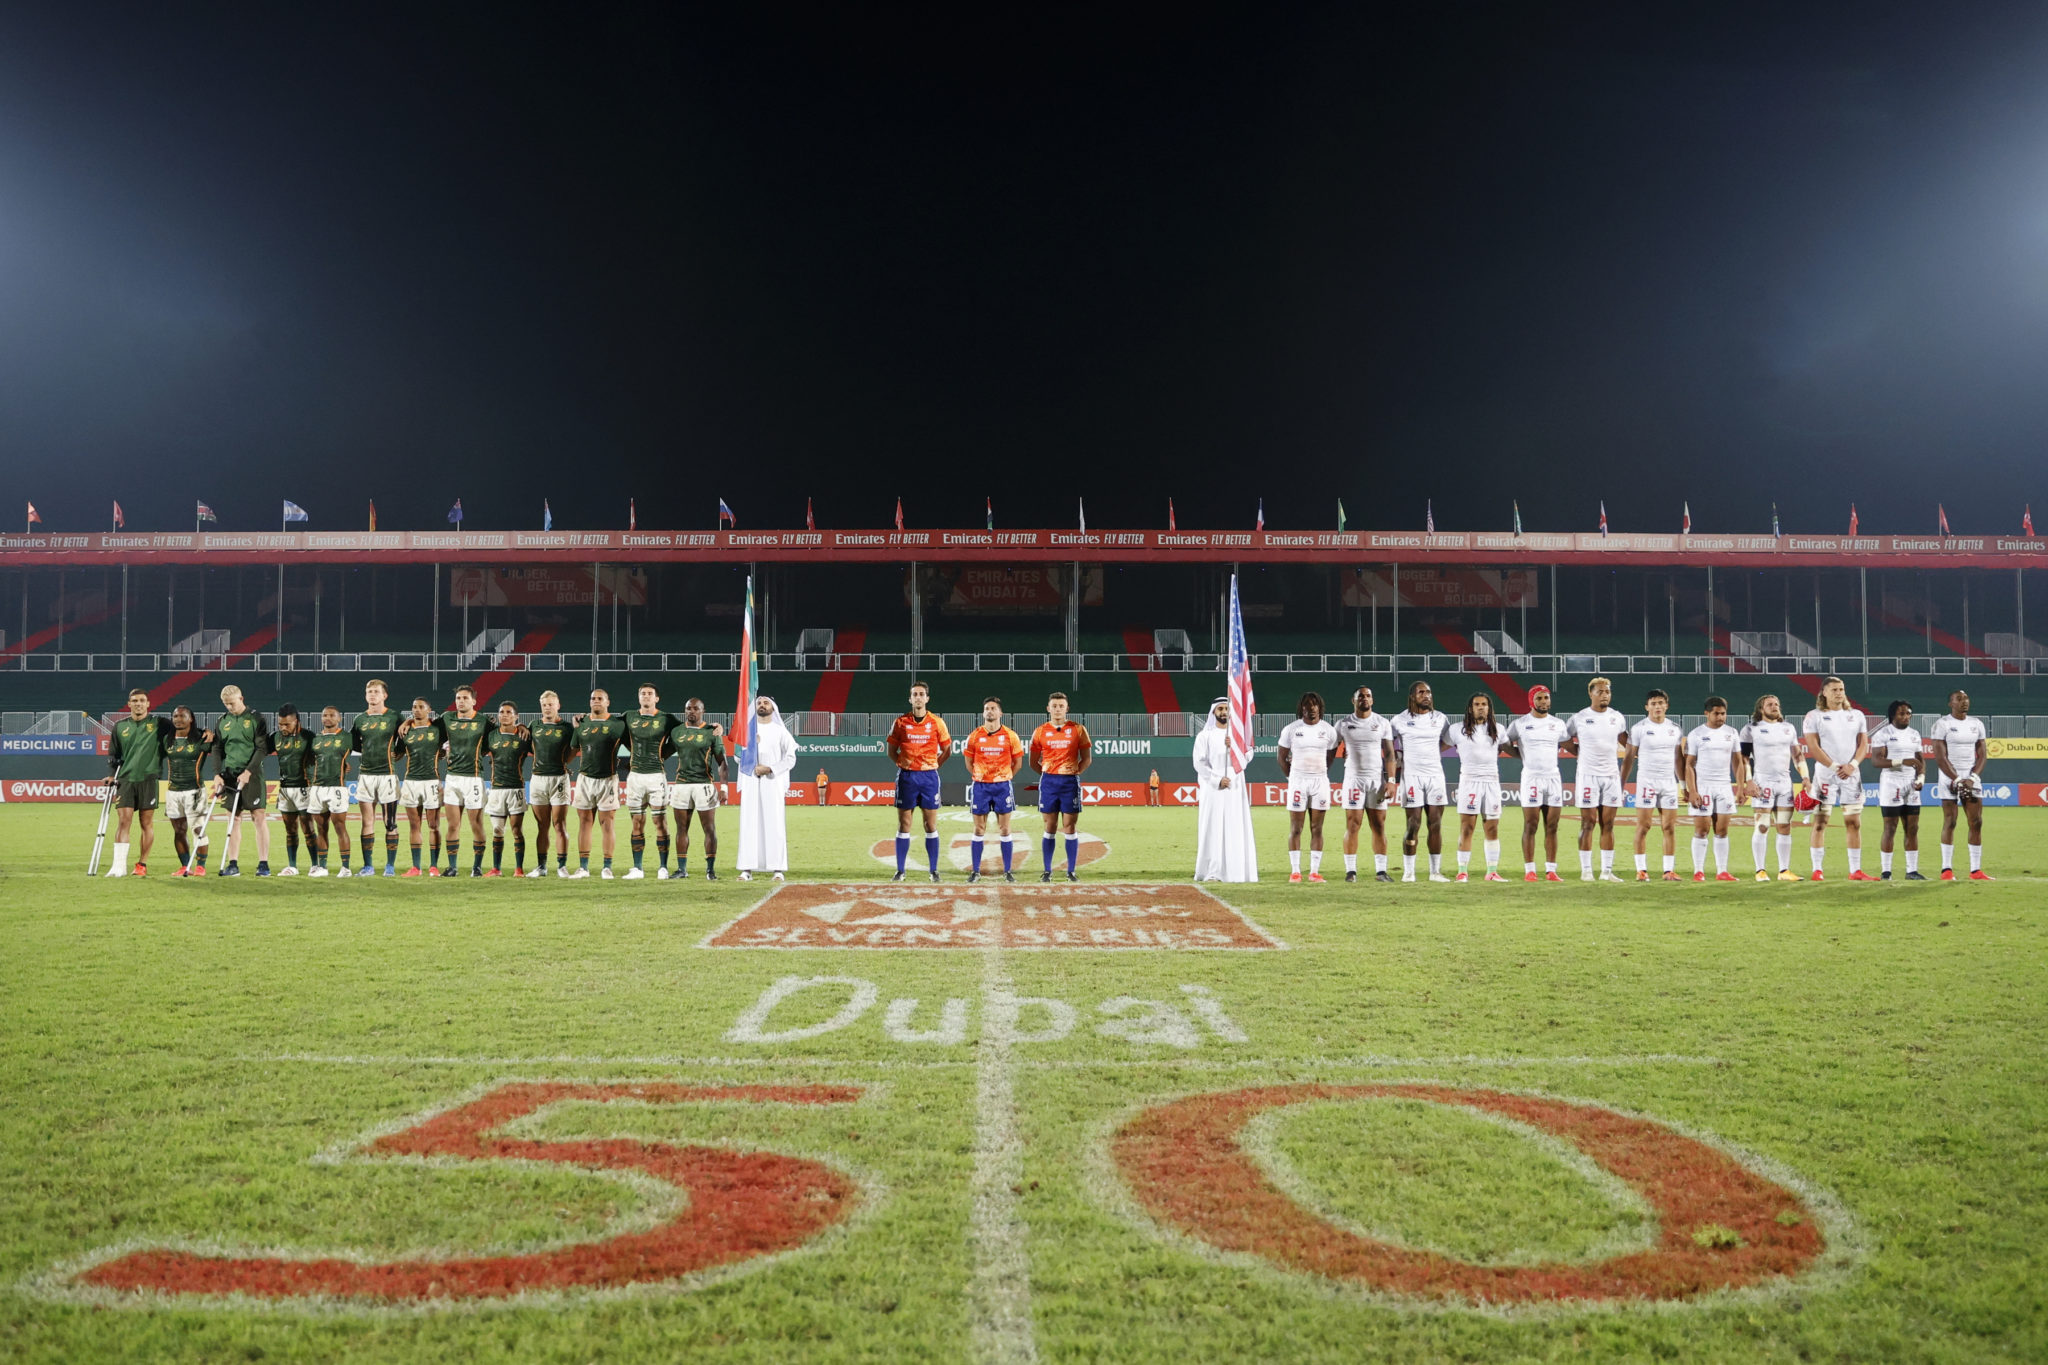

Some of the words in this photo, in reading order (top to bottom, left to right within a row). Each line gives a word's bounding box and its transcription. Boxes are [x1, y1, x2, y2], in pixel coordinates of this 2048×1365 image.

[0, 537, 46, 547] Emirates
[50, 537, 62, 547] FLY
[63, 537, 88, 547] BETTER
[101, 536, 149, 547] Emirates
[153, 536, 165, 546] FLY
[167, 536, 192, 546] BETTER
[204, 536, 253, 546] Emirates
[256, 536, 269, 546] FLY
[270, 536, 295, 546] BETTER
[308, 536, 356, 546] Emirates
[412, 536, 461, 545] Emirates
[465, 536, 477, 545] FLY
[478, 535, 504, 545] BETTER
[517, 535, 565, 545] Emirates
[570, 535, 581, 544] FLY
[583, 535, 609, 545] BETTER
[622, 535, 671, 545] Emirates
[675, 535, 688, 544] FLY
[689, 535, 715, 545] BETTER
[728, 535, 778, 544] Emirates
[782, 534, 794, 544] FLY
[796, 534, 822, 544] BETTER
[835, 534, 885, 544] Emirates
[889, 534, 901, 544] FLY
[903, 534, 929, 544] BETTER
[943, 534, 992, 544] Emirates
[997, 534, 1009, 544] FLY
[1011, 534, 1036, 544] BETTER
[1050, 534, 1100, 544] Emirates
[1104, 534, 1116, 544] FLY
[1118, 534, 1144, 544] BETTER
[1157, 534, 1207, 544] Emirates
[1211, 535, 1224, 544] FLY
[1225, 535, 1251, 544] BETTER
[1264, 535, 1314, 545] Emirates
[1318, 535, 1330, 545] FLY
[1332, 535, 1357, 545] BETTER
[1371, 535, 1420, 545] Emirates
[1425, 536, 1436, 545] FLY
[1439, 536, 1464, 546] BETTER
[1477, 536, 1526, 547] Emirates
[1581, 537, 1630, 547] Emirates
[1685, 537, 1734, 548] Emirates
[1738, 537, 1749, 548] FLY
[1751, 537, 1776, 548] BETTER
[1789, 539, 1837, 549] Emirates
[1841, 539, 1853, 549] FLY
[1855, 540, 1879, 549] BETTER
[1892, 539, 1940, 549] Emirates
[1944, 540, 1956, 549] FLY
[1958, 540, 1983, 550] BETTER
[1996, 540, 2045, 550] Emirates
[967, 570, 1040, 583] EMIRATES
[971, 586, 1016, 598] DUBAI
[3, 740, 76, 750] MEDICLINIC
[809, 744, 839, 752] Sevens
[840, 743, 877, 752] Stadium
[1094, 740, 1151, 755] STADIUM
[2006, 743, 2034, 751] Dubai
[11, 782, 112, 801] @WorldRug
[473, 785, 479, 795] 5
[785, 790, 804, 798] SBC
[877, 789, 896, 798] HSB
[1107, 790, 1132, 798] HSBC
[1408, 786, 1415, 798] 4
[1530, 786, 1537, 798] 3
[1584, 787, 1591, 799] 2
[1763, 787, 1771, 799] 9
[1822, 783, 1829, 795] 5
[335, 790, 341, 800] 9
[515, 790, 523, 801] 10
[1293, 790, 1301, 802] 6
[1348, 788, 1360, 801] 12
[1468, 793, 1476, 805] 7
[1024, 905, 1193, 919] HSBC
[741, 927, 995, 944] SEVENS
[1011, 928, 1234, 944] SERIES
[722, 974, 1249, 1048] Dubai
